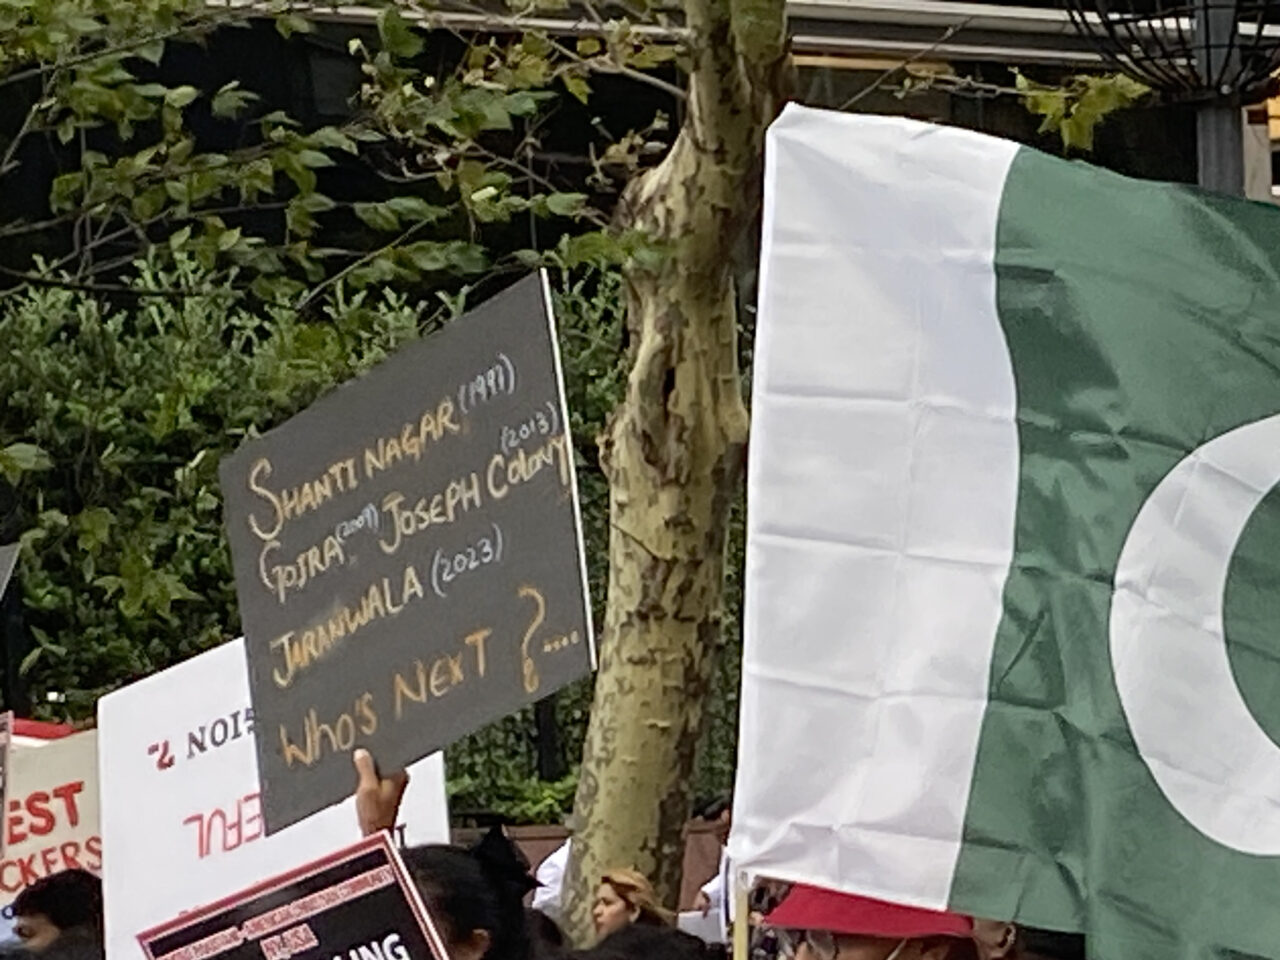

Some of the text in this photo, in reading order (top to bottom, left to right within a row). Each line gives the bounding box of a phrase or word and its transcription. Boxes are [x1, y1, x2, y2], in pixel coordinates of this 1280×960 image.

[249, 458, 358, 542] SHANTI
[363, 397, 461, 485] NAGAR
[379, 472, 482, 554] JOSEPH
[430, 523, 505, 598] (2023)
